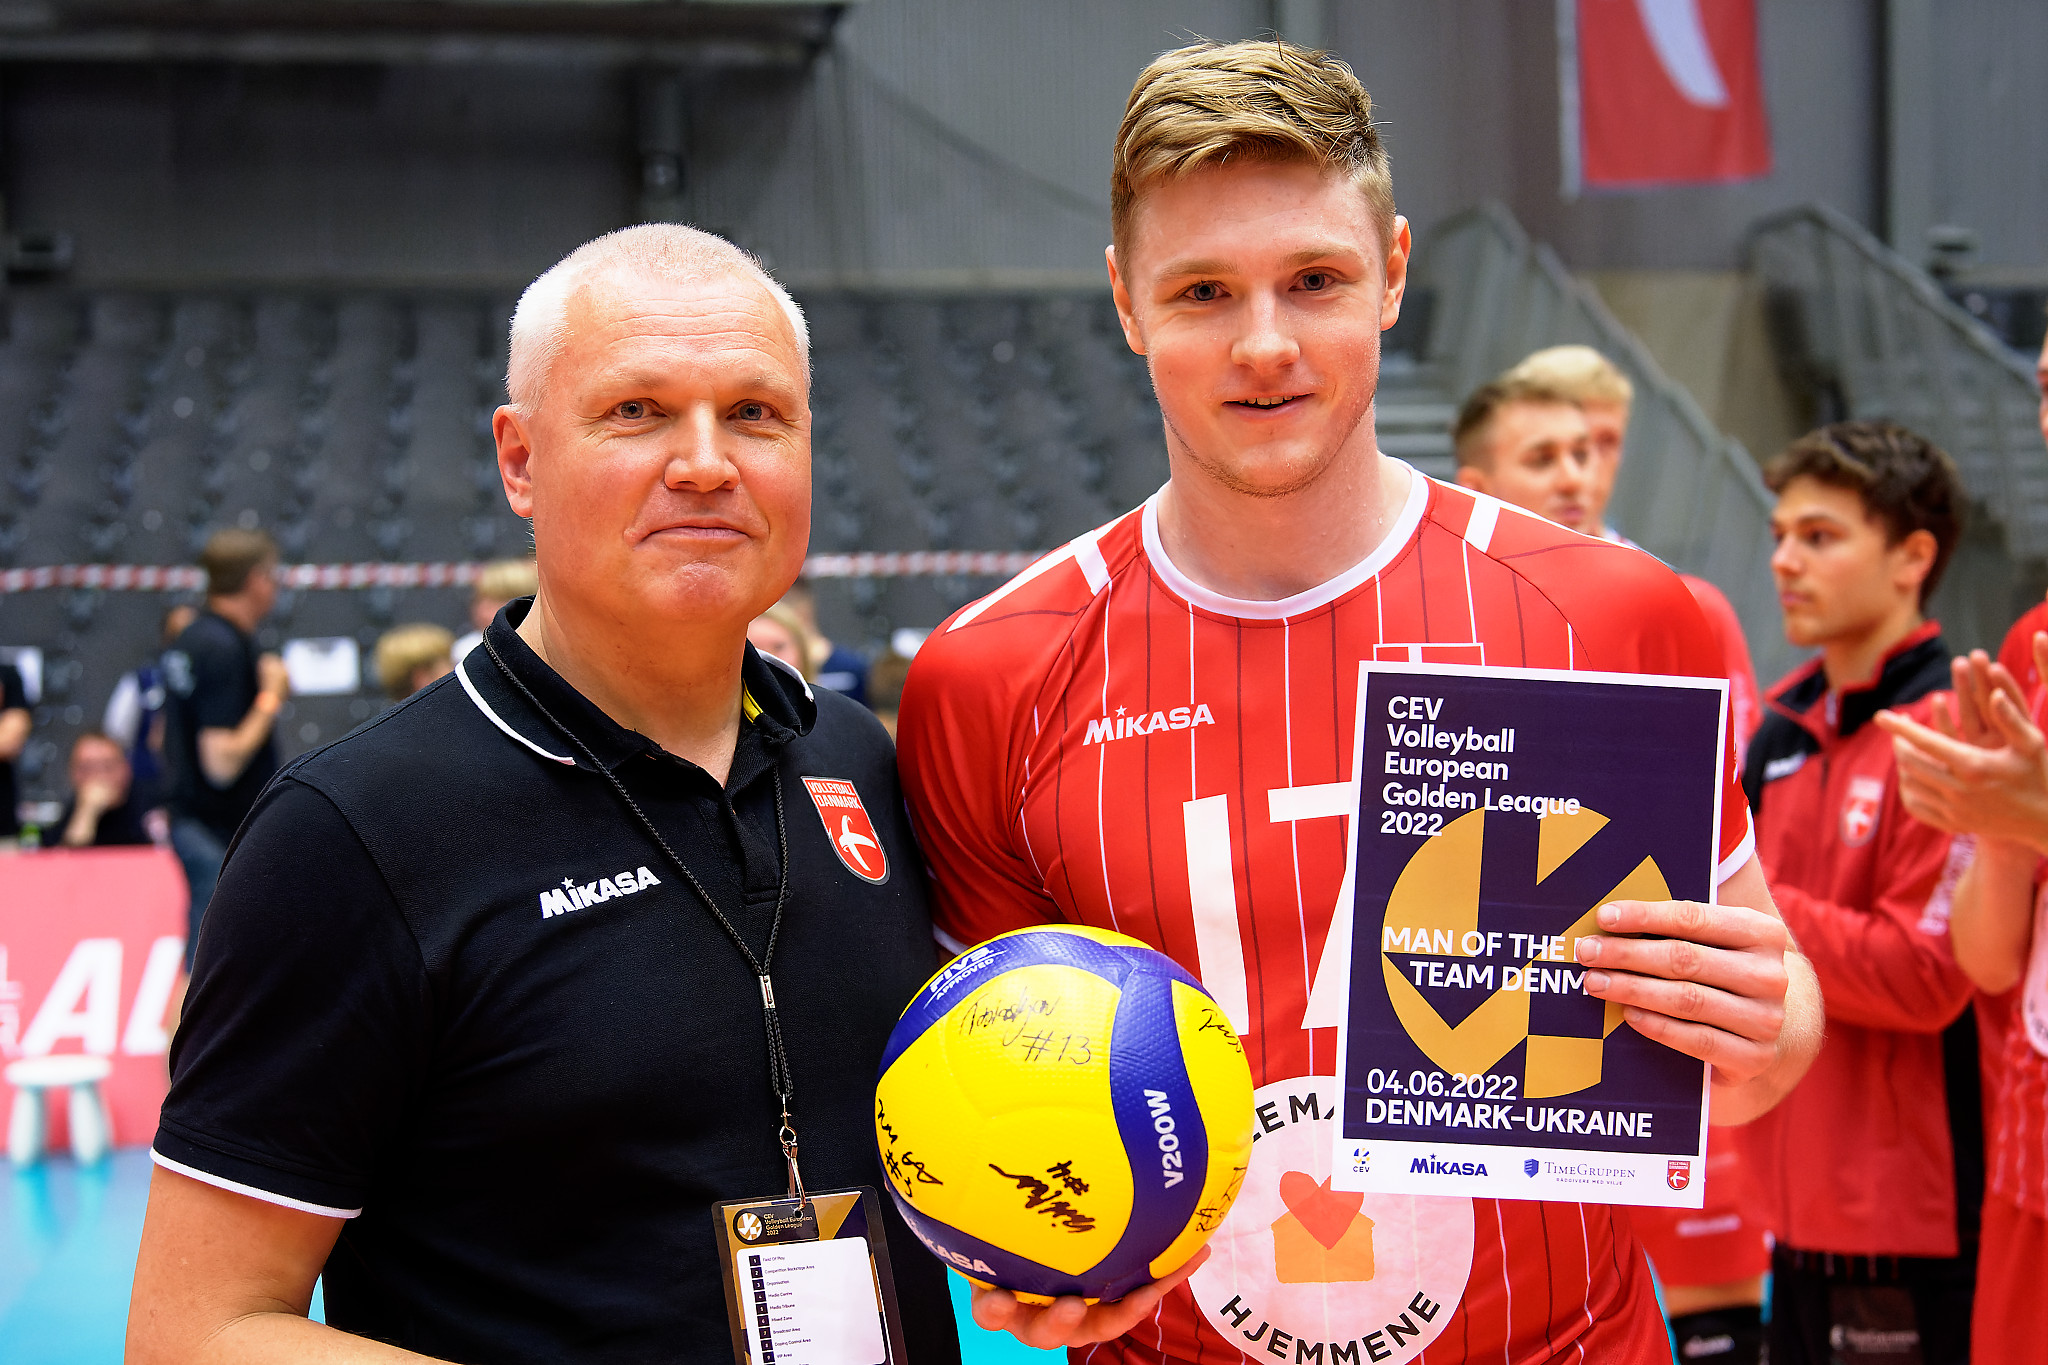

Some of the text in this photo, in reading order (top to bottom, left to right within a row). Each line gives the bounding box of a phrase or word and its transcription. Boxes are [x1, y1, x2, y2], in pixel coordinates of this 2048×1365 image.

[1082, 703, 1216, 746] MIKASA
[1388, 696, 1443, 721] CEV
[1387, 723, 1515, 755] Volleyball
[1384, 751, 1509, 782] European
[807, 781, 855, 796] VOLLEYBALL
[814, 795, 862, 809] DANMARK
[1382, 782, 1580, 820] Golden League
[1381, 811, 1443, 837] 2022
[539, 866, 662, 919] MIKASA
[1383, 926, 1454, 956] MAN
[1461, 931, 1502, 958] OF
[1508, 933, 1566, 961] THE
[936, 958, 994, 1000] APPROVED
[1410, 960, 1589, 996] TEAM DENM
[1367, 1068, 1518, 1101] 04.06.2022
[1366, 1098, 1653, 1138] DENMARK-UKRAINE
[1144, 1088, 1184, 1189] V200W
[1410, 1154, 1488, 1176] MIKASA
[1219, 1291, 1441, 1365] HJEMMENE
